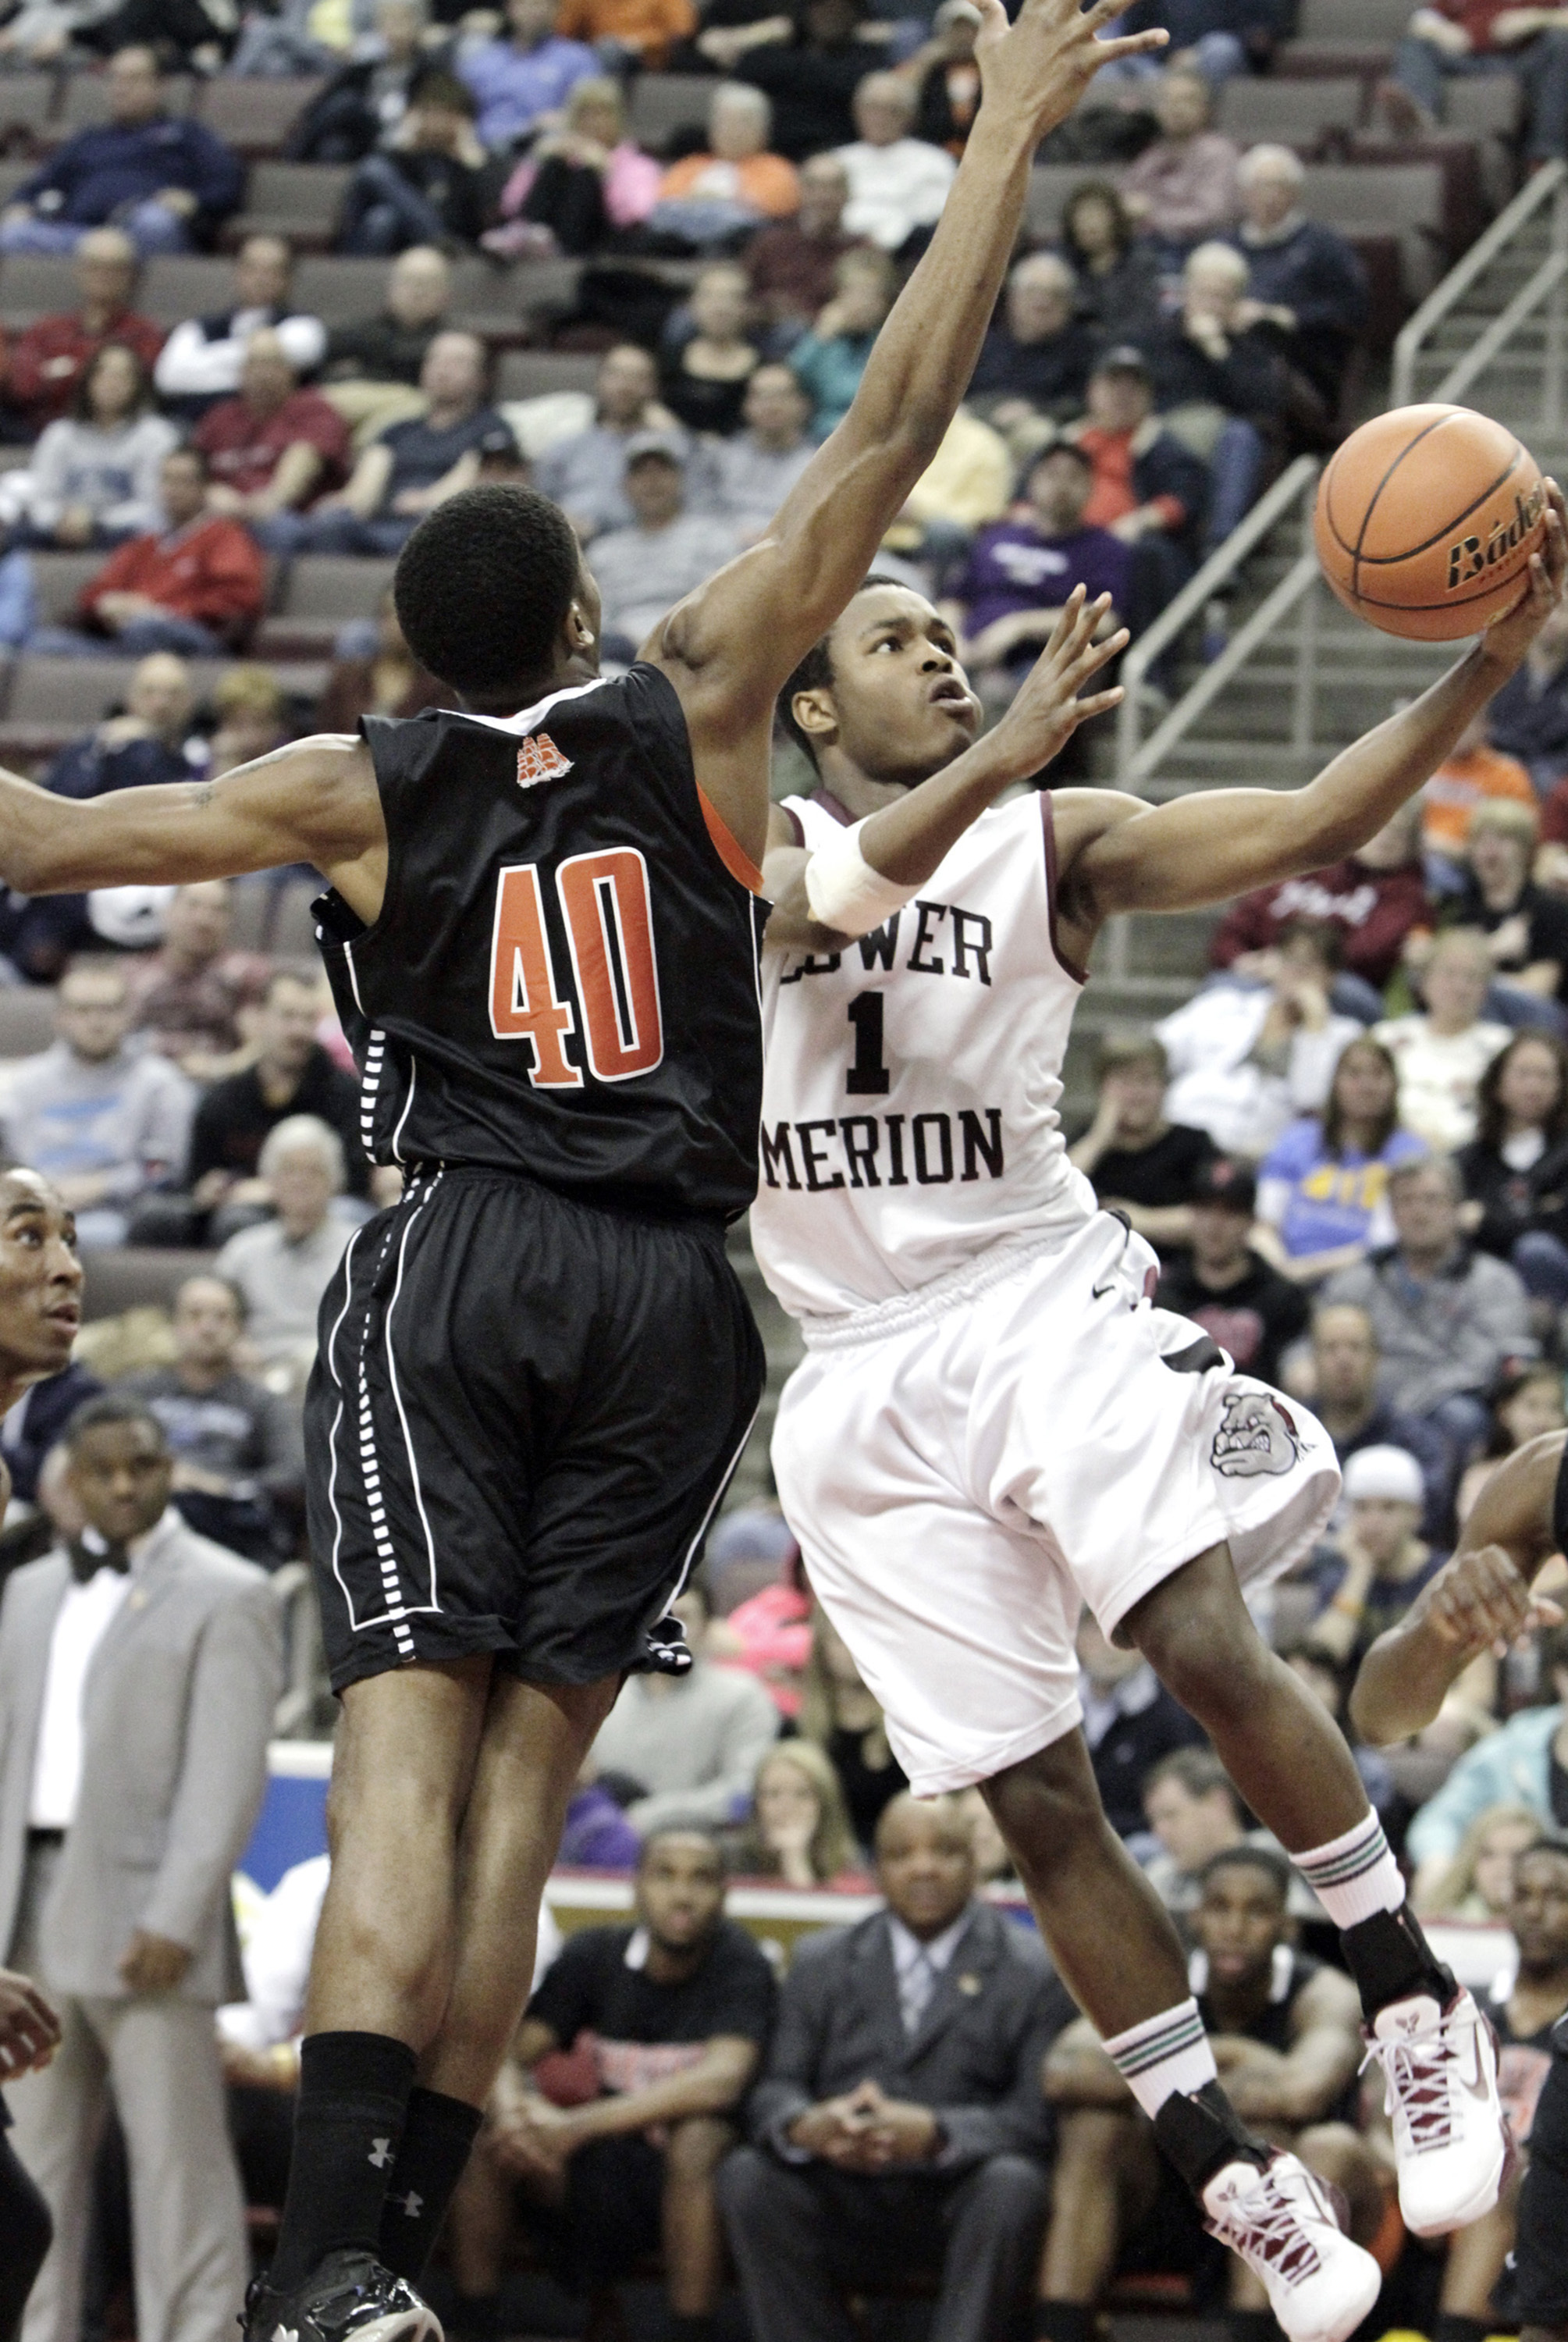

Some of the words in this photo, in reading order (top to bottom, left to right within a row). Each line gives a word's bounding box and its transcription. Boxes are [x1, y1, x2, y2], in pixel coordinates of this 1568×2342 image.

[488, 845, 664, 1089] 40
[780, 899, 993, 987] WER
[845, 991, 890, 1094] 1
[761, 1109, 1004, 1192] MERION
